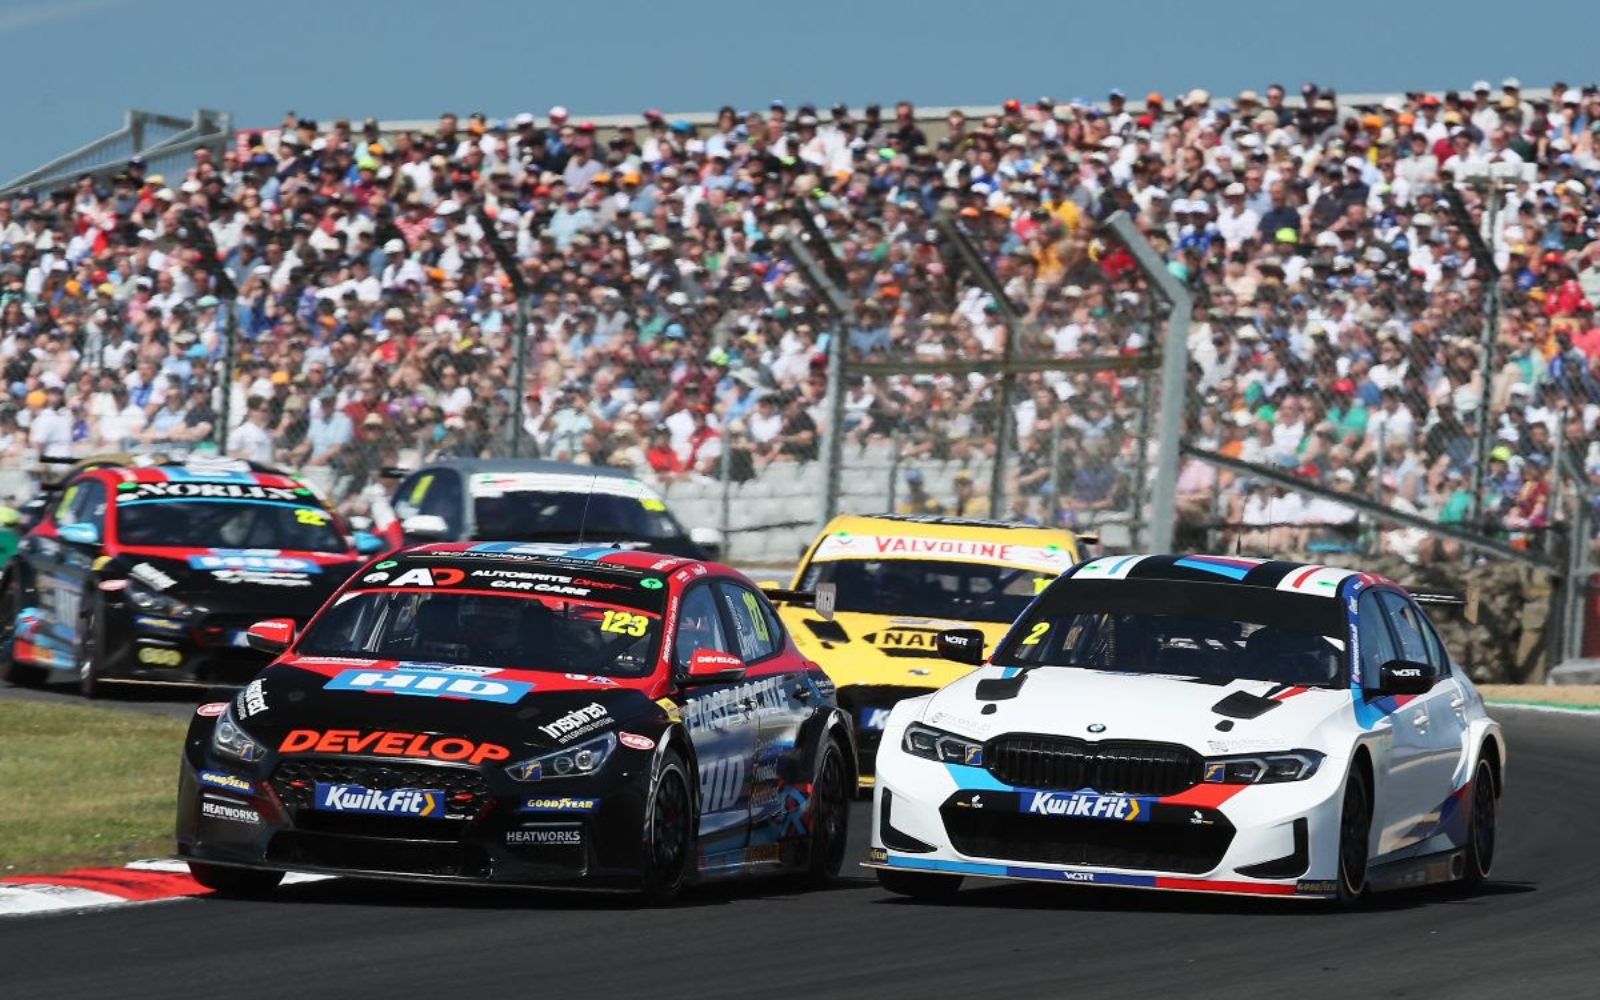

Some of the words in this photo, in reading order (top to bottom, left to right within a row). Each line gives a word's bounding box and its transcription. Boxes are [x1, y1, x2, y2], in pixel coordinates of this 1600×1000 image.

[875, 536, 1014, 561] VALVOLINE
[388, 567, 465, 586] AD
[470, 570, 573, 584] AUTOBRITE
[490, 580, 534, 590] CAR
[534, 583, 591, 596] CARE
[600, 610, 649, 637] 123
[1022, 622, 1051, 645] 2
[697, 655, 741, 665] DEVELOP
[350, 672, 509, 695] HID
[279, 729, 511, 765] DEVELOP
[202, 773, 250, 790] GOODYEAR
[203, 802, 259, 822] HEATWORKS
[527, 797, 594, 809] GOODYEAR
[506, 830, 581, 842] HEATWORKS
[1064, 871, 1094, 882] WSR
